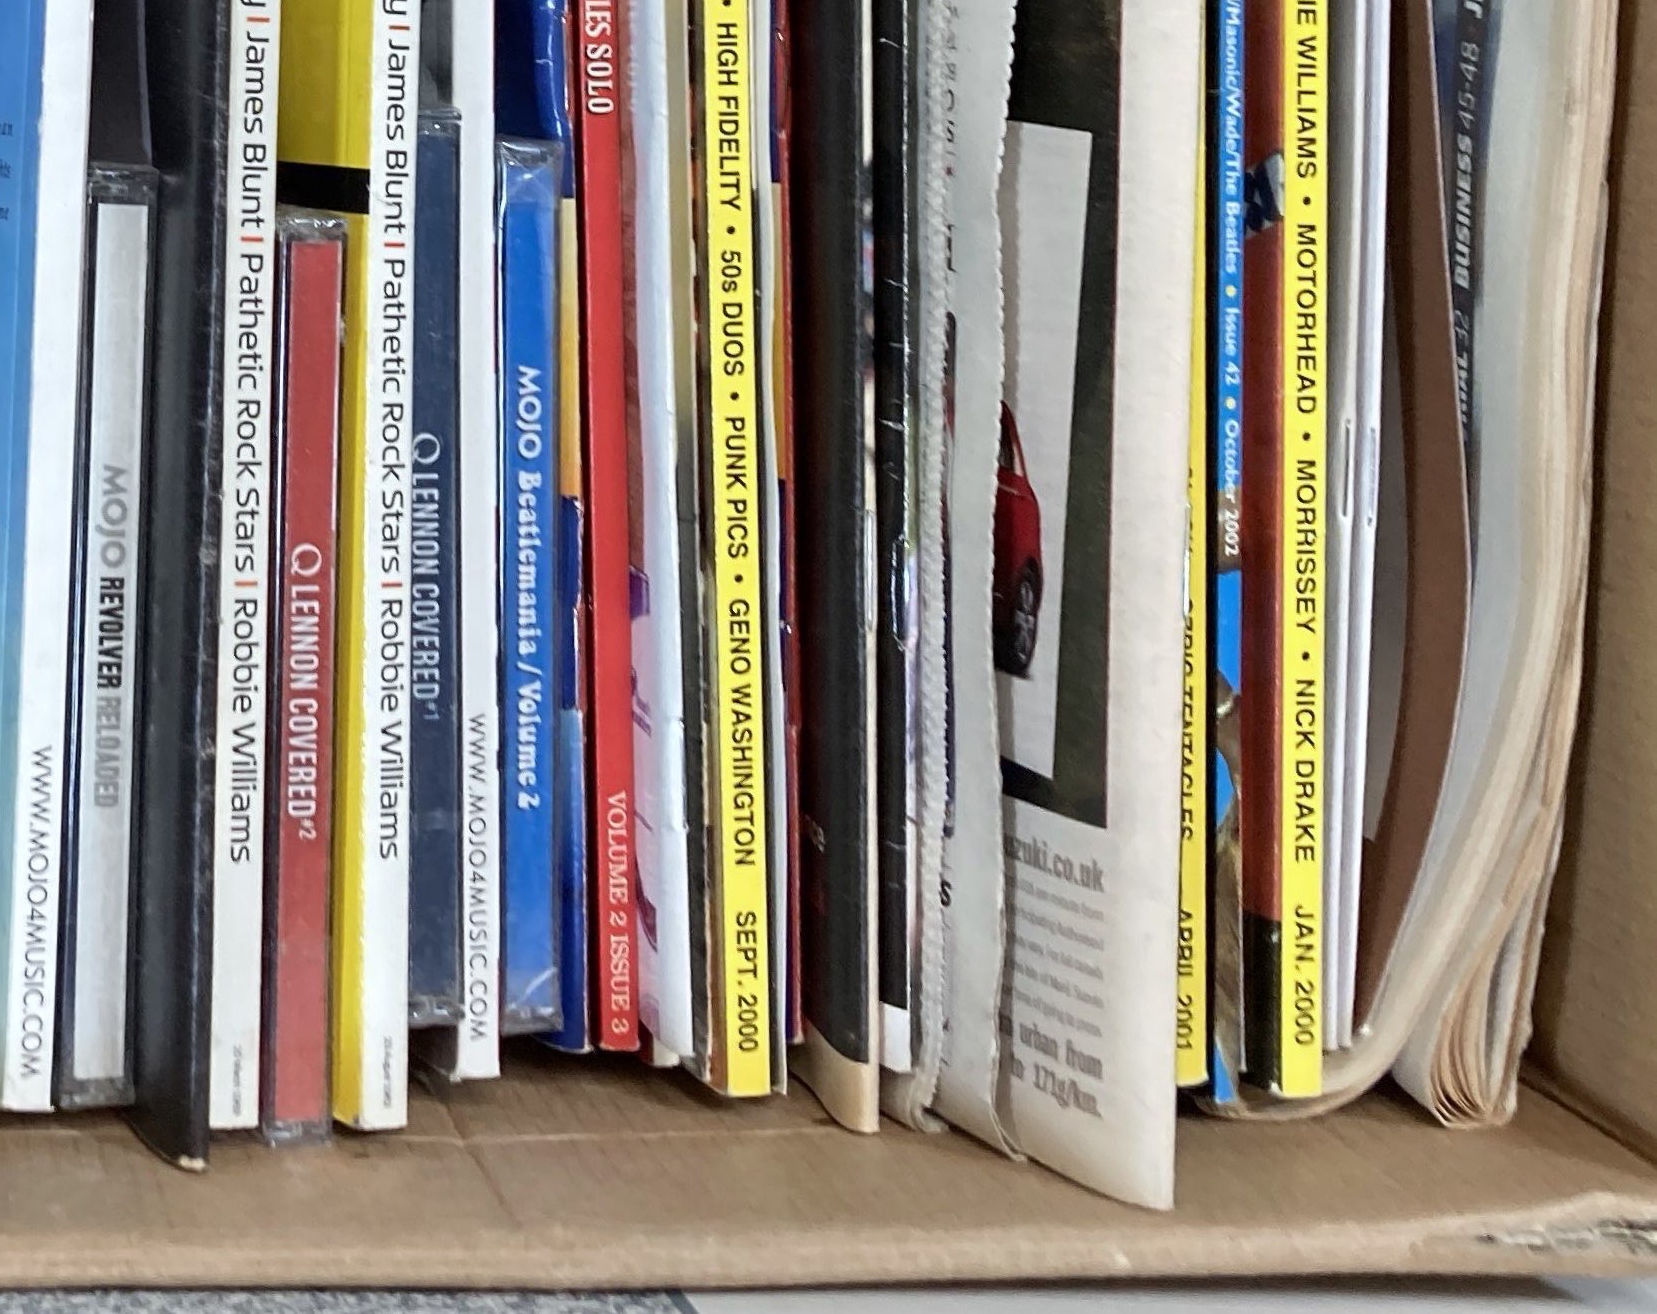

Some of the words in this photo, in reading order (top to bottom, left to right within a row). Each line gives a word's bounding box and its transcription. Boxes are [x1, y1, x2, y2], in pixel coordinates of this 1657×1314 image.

[387, 39, 409, 140] James
[587, 44, 614, 113] SOLO
[717, 23, 738, 85] HIGH
[1297, 36, 1316, 178] WILLIAMS
[384, 150, 409, 233] Blunt
[719, 96, 740, 210] FIDELITY
[721, 251, 741, 292] 50s
[1226, 202, 1240, 273] Beatles
[383, 259, 406, 392] Pathetic
[723, 303, 744, 375] DUOS
[1225, 308, 1240, 356] Issue
[1297, 225, 1316, 413] MOTORHEAD
[516, 366, 541, 458] MOJO
[1225, 362, 1239, 385] 42
[382, 403, 405, 481] Rock
[725, 418, 746, 489] PUNK
[1225, 419, 1239, 503] October
[96, 465, 129, 568] MOJO
[382, 490, 403, 573] Stars
[727, 500, 748, 558] PICS
[1219, 509, 1239, 556] 2002
[1296, 460, 1316, 633] MORRISSEY
[519, 471, 542, 655] Beatlemania
[97, 578, 124, 688] REVOLVER
[290, 585, 319, 689] LENNON
[381, 600, 404, 712] Robbie
[729, 599, 750, 674] GENO
[95, 696, 121, 808] RELOADED
[518, 681, 541, 786] Volume
[1296, 680, 1315, 748] NICK
[380, 721, 403, 859] Williams
[518, 792, 539, 809] 2
[732, 684, 754, 865] WASHINGTON
[1296, 761, 1314, 862] DRAKE
[608, 791, 628, 904] VOLUME
[21, 745, 52, 1078] WWW.MOJO4MUSIC.COM
[610, 911, 627, 926] 2
[736, 912, 757, 985] SEPT.
[1295, 906, 1314, 970] JAN.
[610, 934, 629, 1010] ISSUE
[1295, 981, 1314, 1045] 2000
[612, 1018, 629, 1033] 3
[738, 995, 758, 1052] 2000
